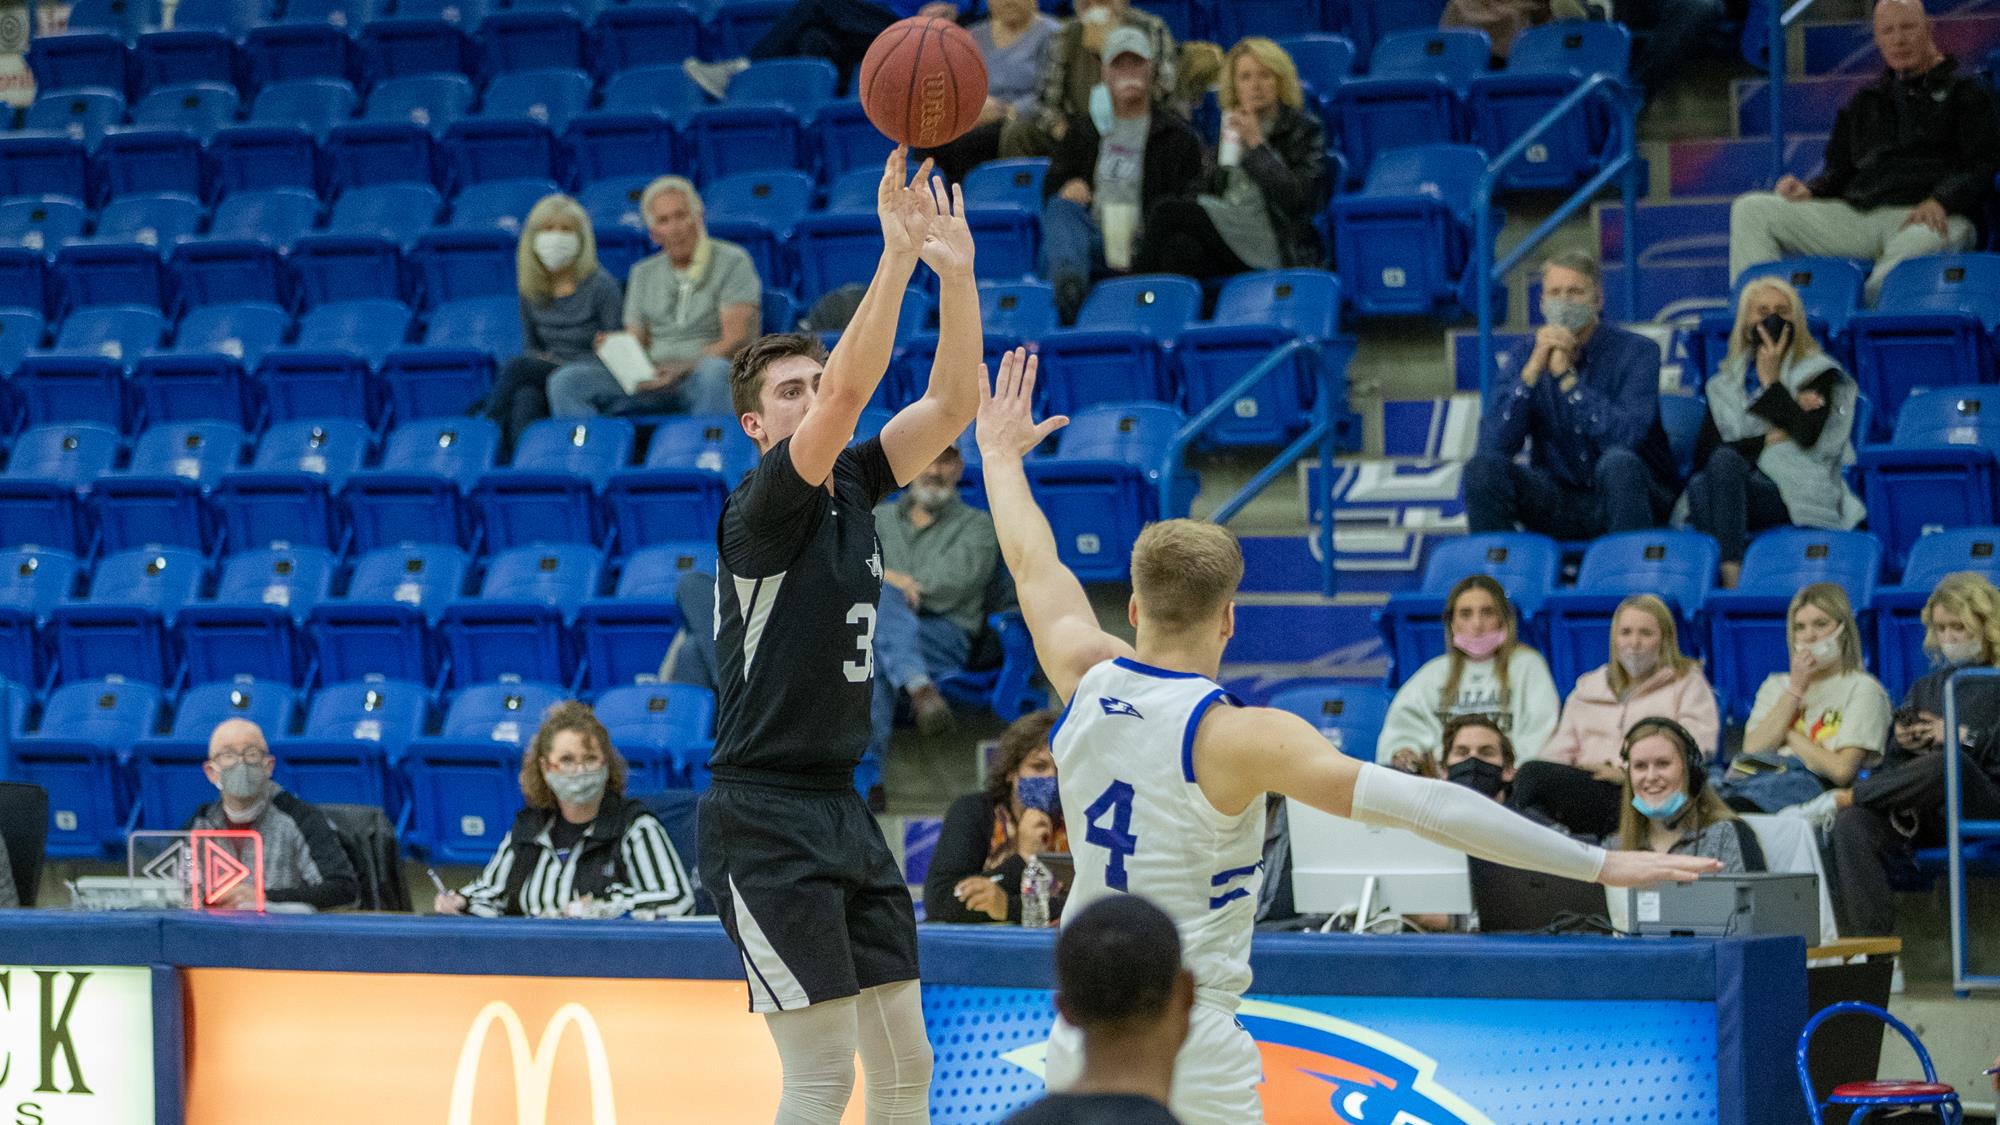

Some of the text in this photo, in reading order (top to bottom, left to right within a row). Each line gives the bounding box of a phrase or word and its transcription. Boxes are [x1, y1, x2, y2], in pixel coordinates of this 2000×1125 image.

[842, 602, 876, 683] 3
[1083, 779, 1138, 893] 4
[0, 969, 95, 1095] K
